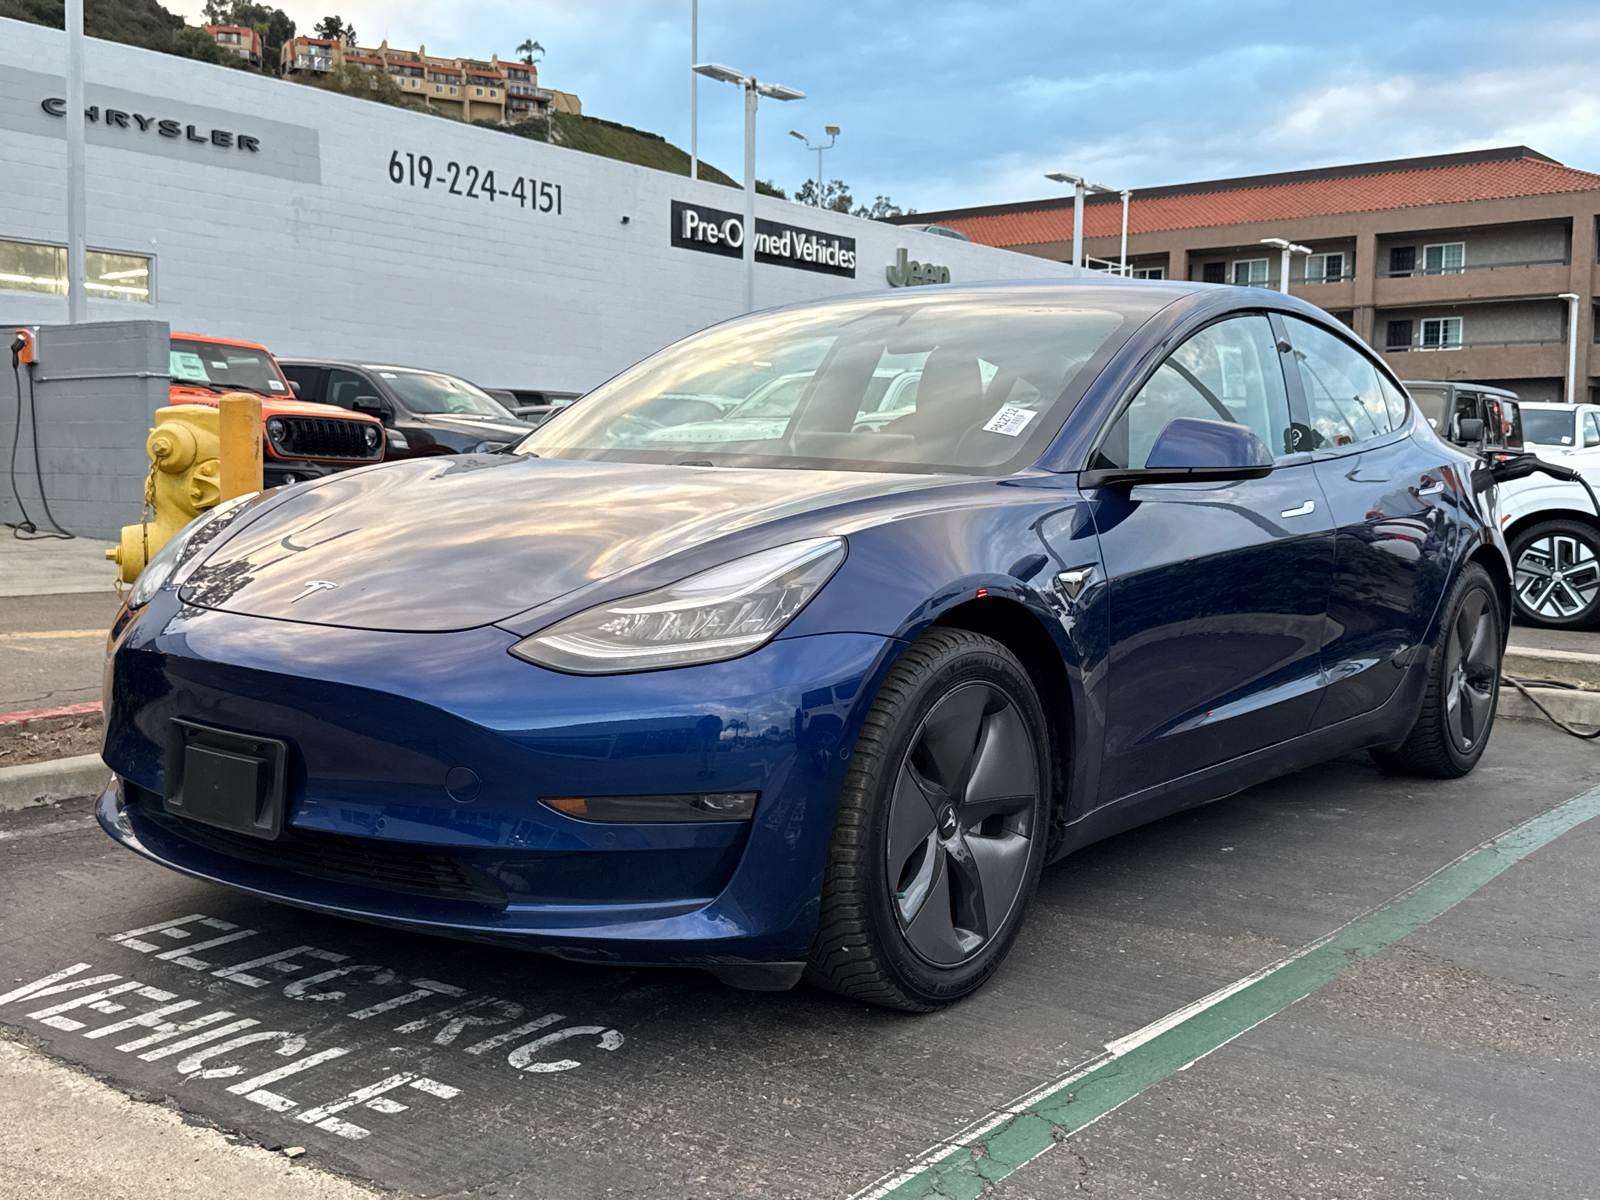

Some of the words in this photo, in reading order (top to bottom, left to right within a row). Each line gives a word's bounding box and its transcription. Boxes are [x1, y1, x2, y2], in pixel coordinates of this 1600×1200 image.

[41, 97, 261, 153] CHRYSLER
[389, 150, 563, 216] 619-224-4151
[681, 209, 791, 258] Pre-Oned
[791, 230, 856, 269] Vehicles
[106, 913, 625, 1074] ELECTRIC
[0, 961, 462, 1140] VEHICLE
